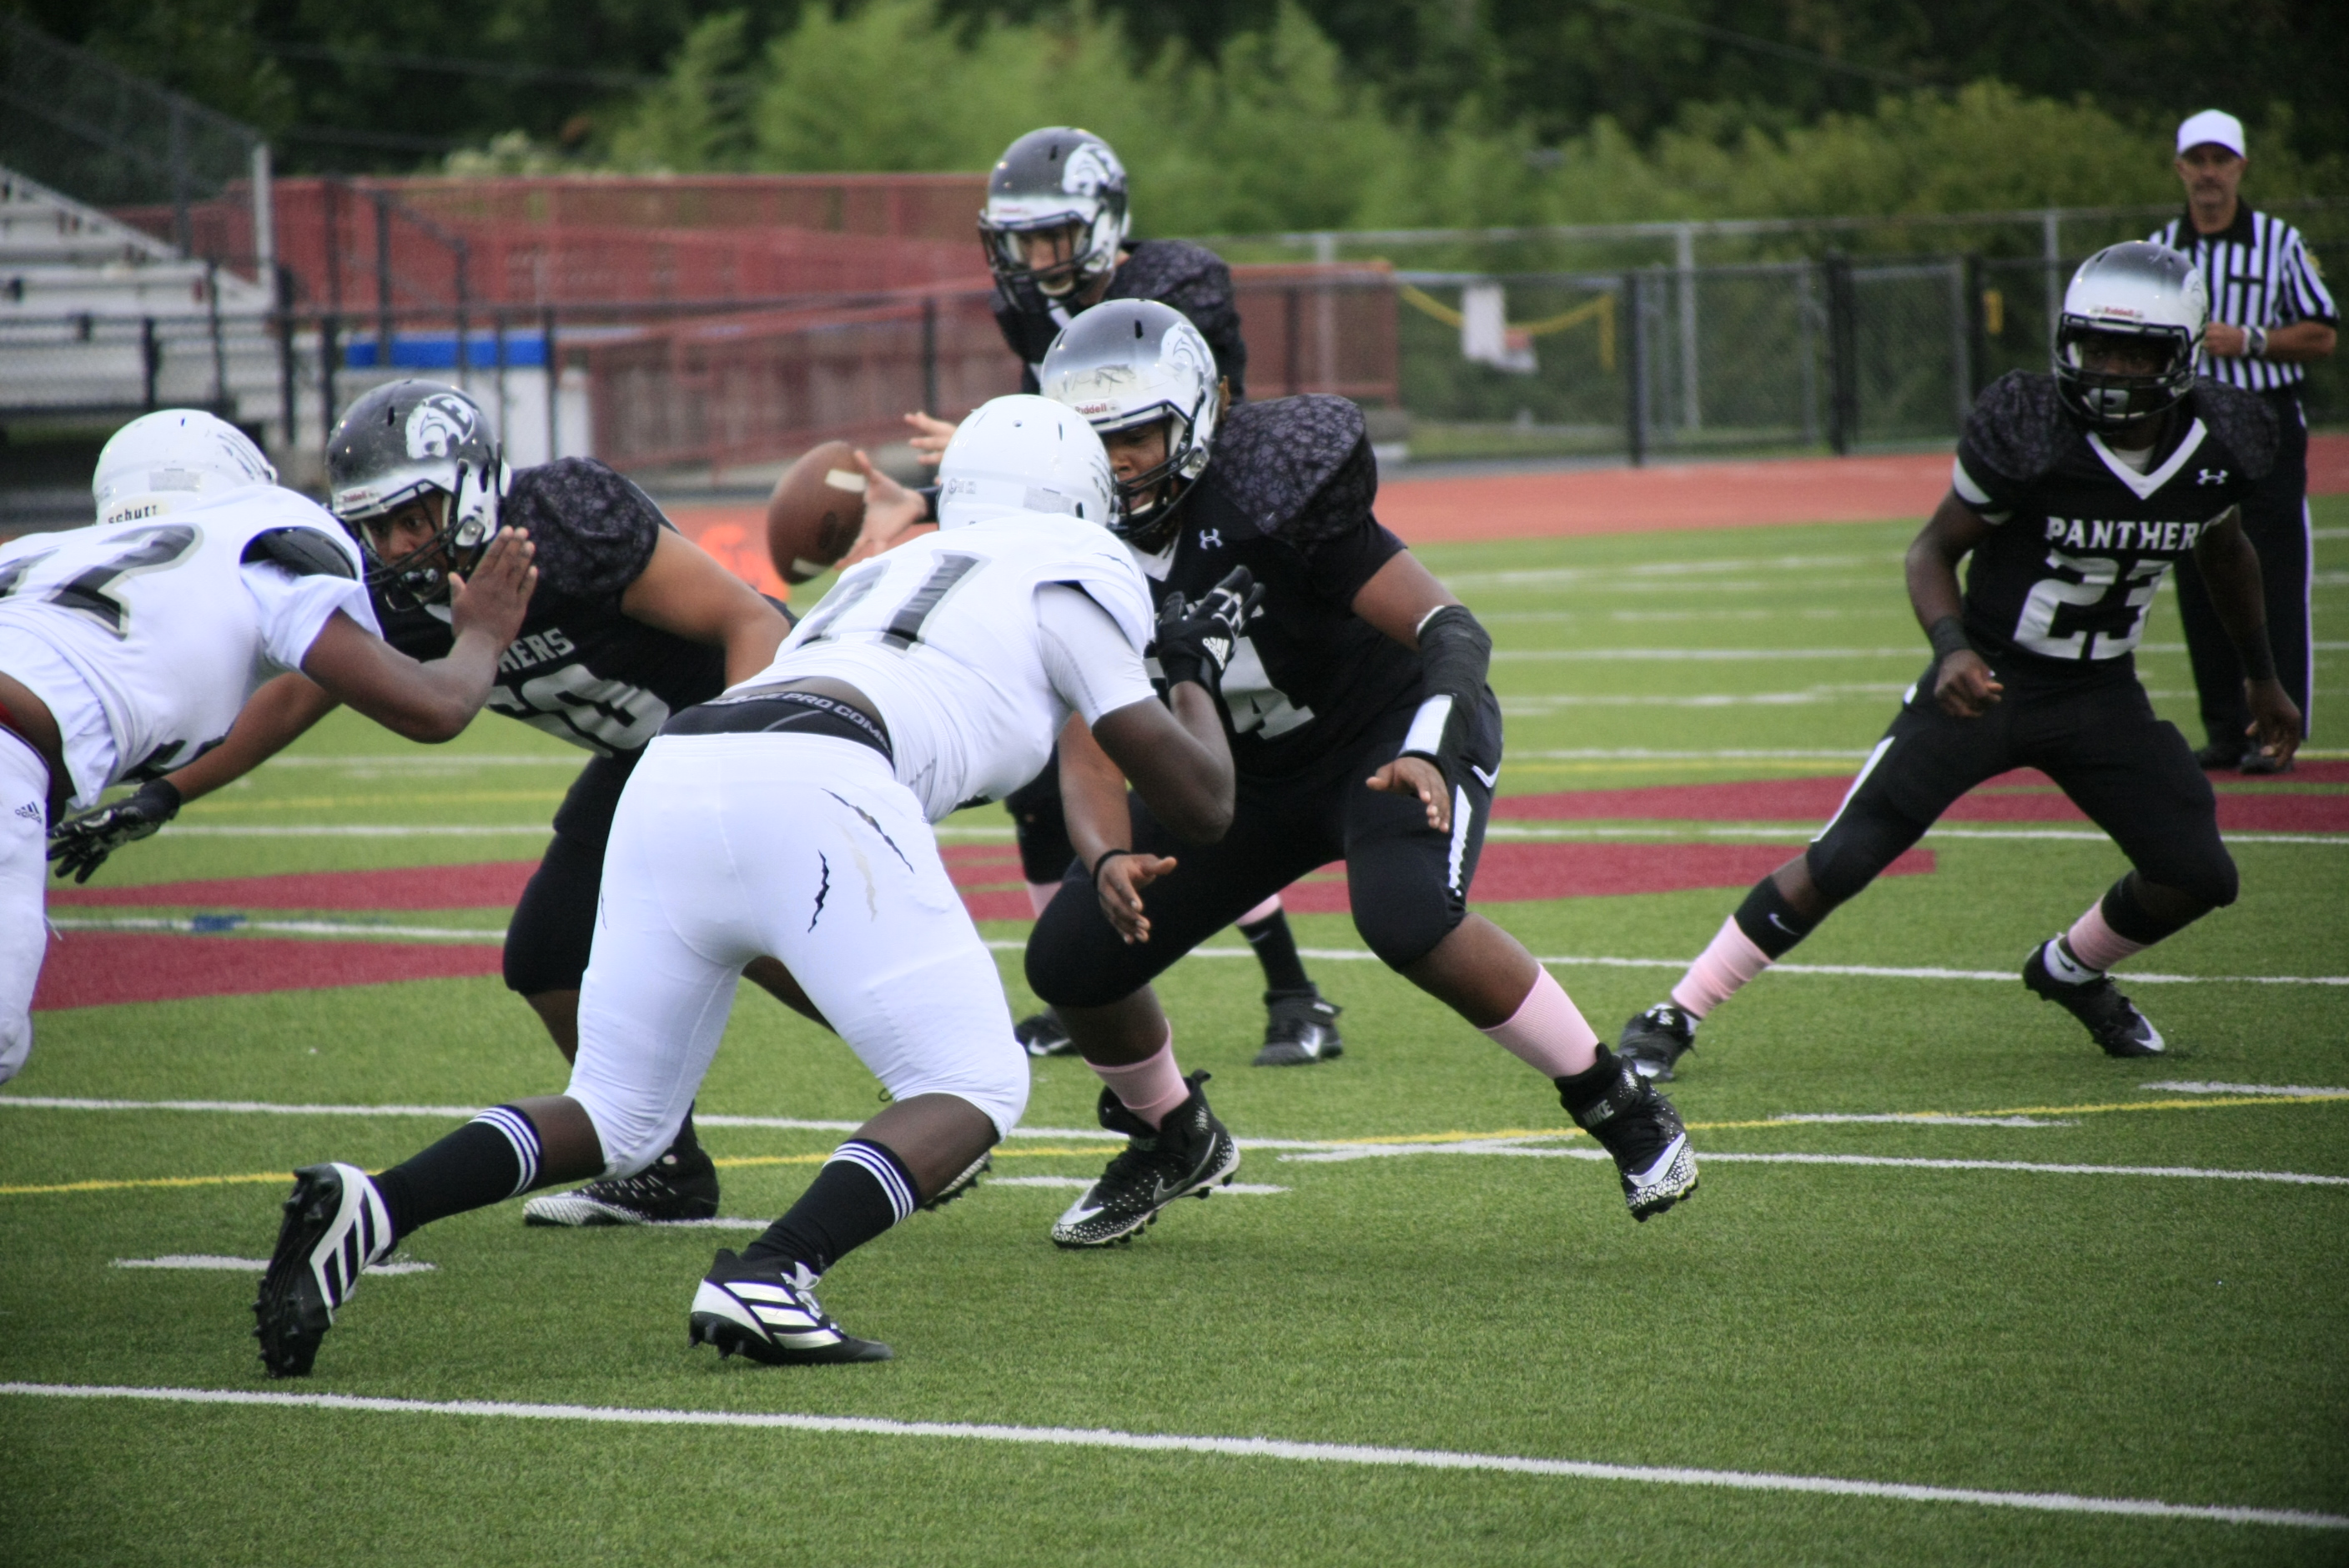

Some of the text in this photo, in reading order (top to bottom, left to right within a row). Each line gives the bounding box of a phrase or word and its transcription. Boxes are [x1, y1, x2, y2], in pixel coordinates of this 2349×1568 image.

[2045, 516, 2207, 550] PANTHER
[2013, 547, 2175, 660] 23
[497, 627, 576, 673] HERS
[782, 692, 833, 710] PRO
[833, 704, 893, 755] COM
